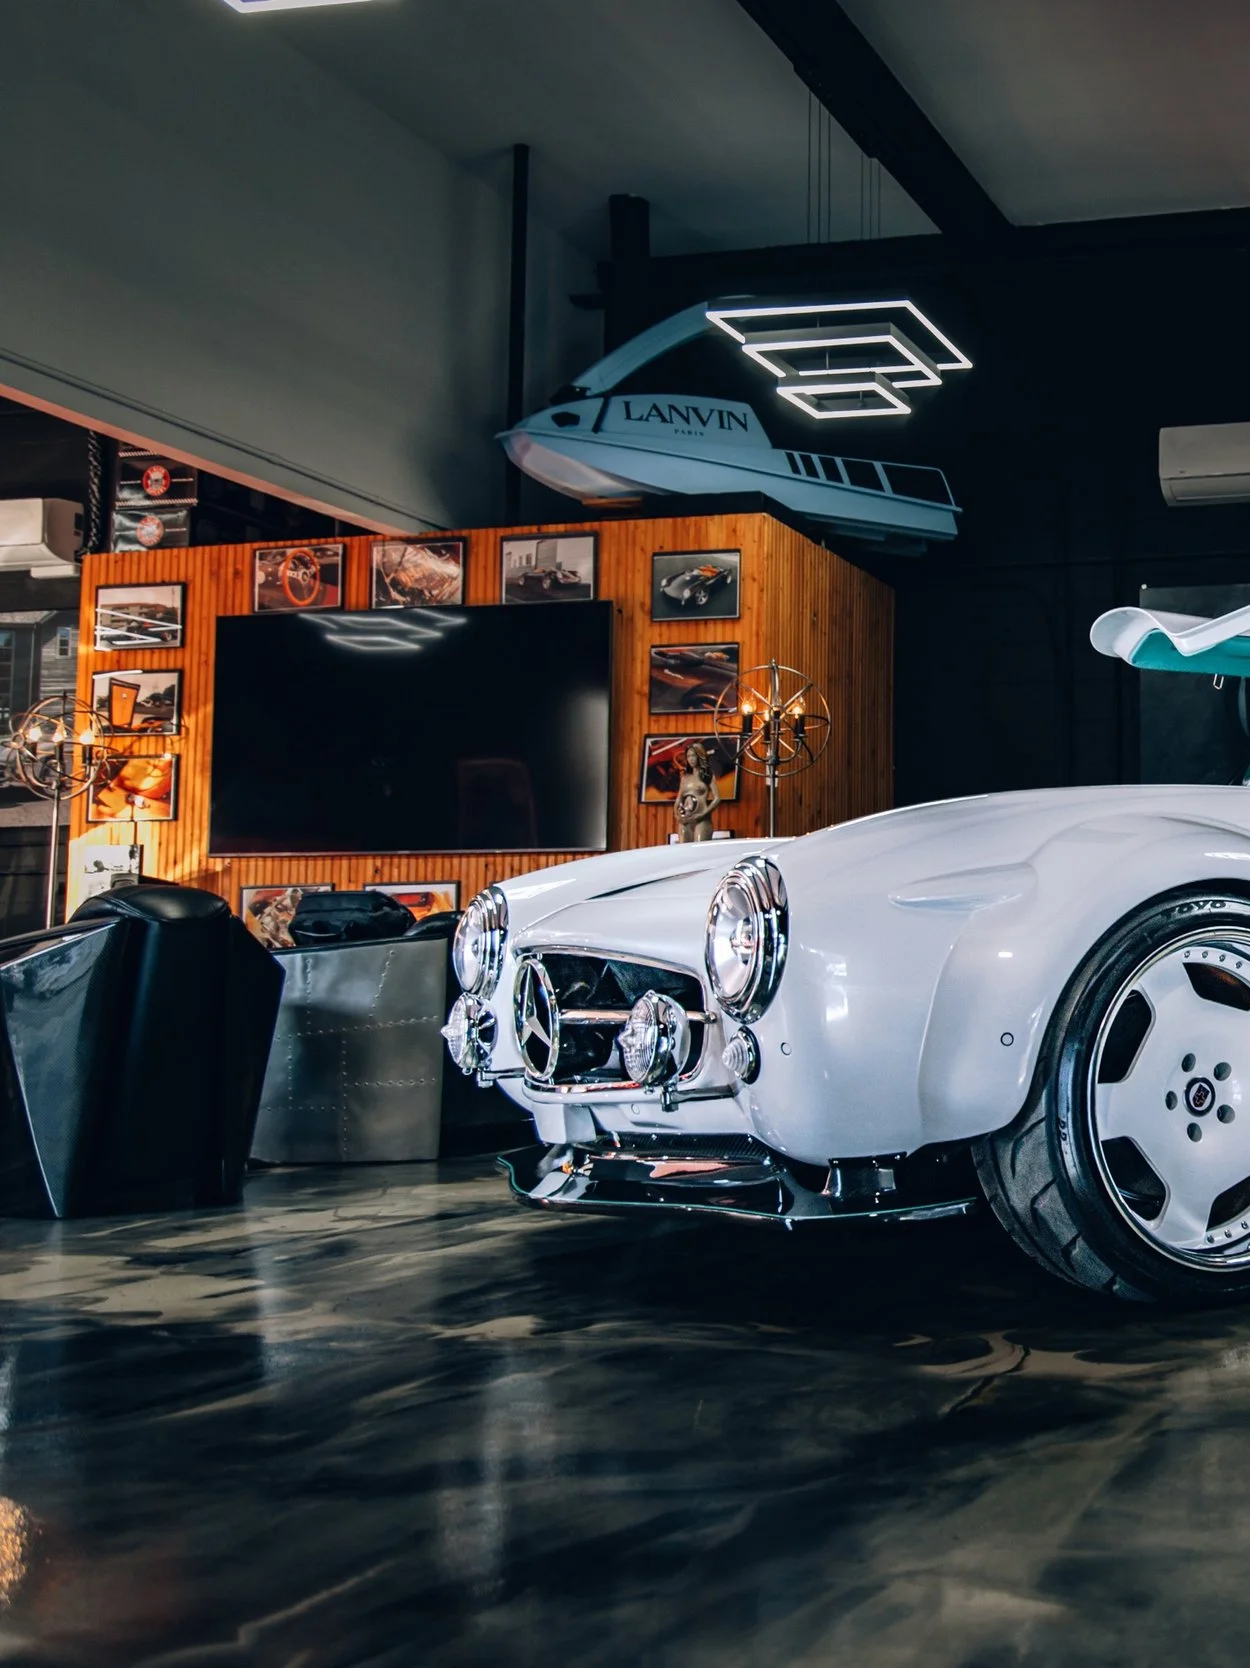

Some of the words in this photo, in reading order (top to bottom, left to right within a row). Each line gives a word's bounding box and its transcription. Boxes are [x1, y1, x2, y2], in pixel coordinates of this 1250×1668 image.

[623, 400, 748, 432] LANVIN
[674, 428, 704, 436] PARIS
[1160, 899, 1227, 919] TOYO
